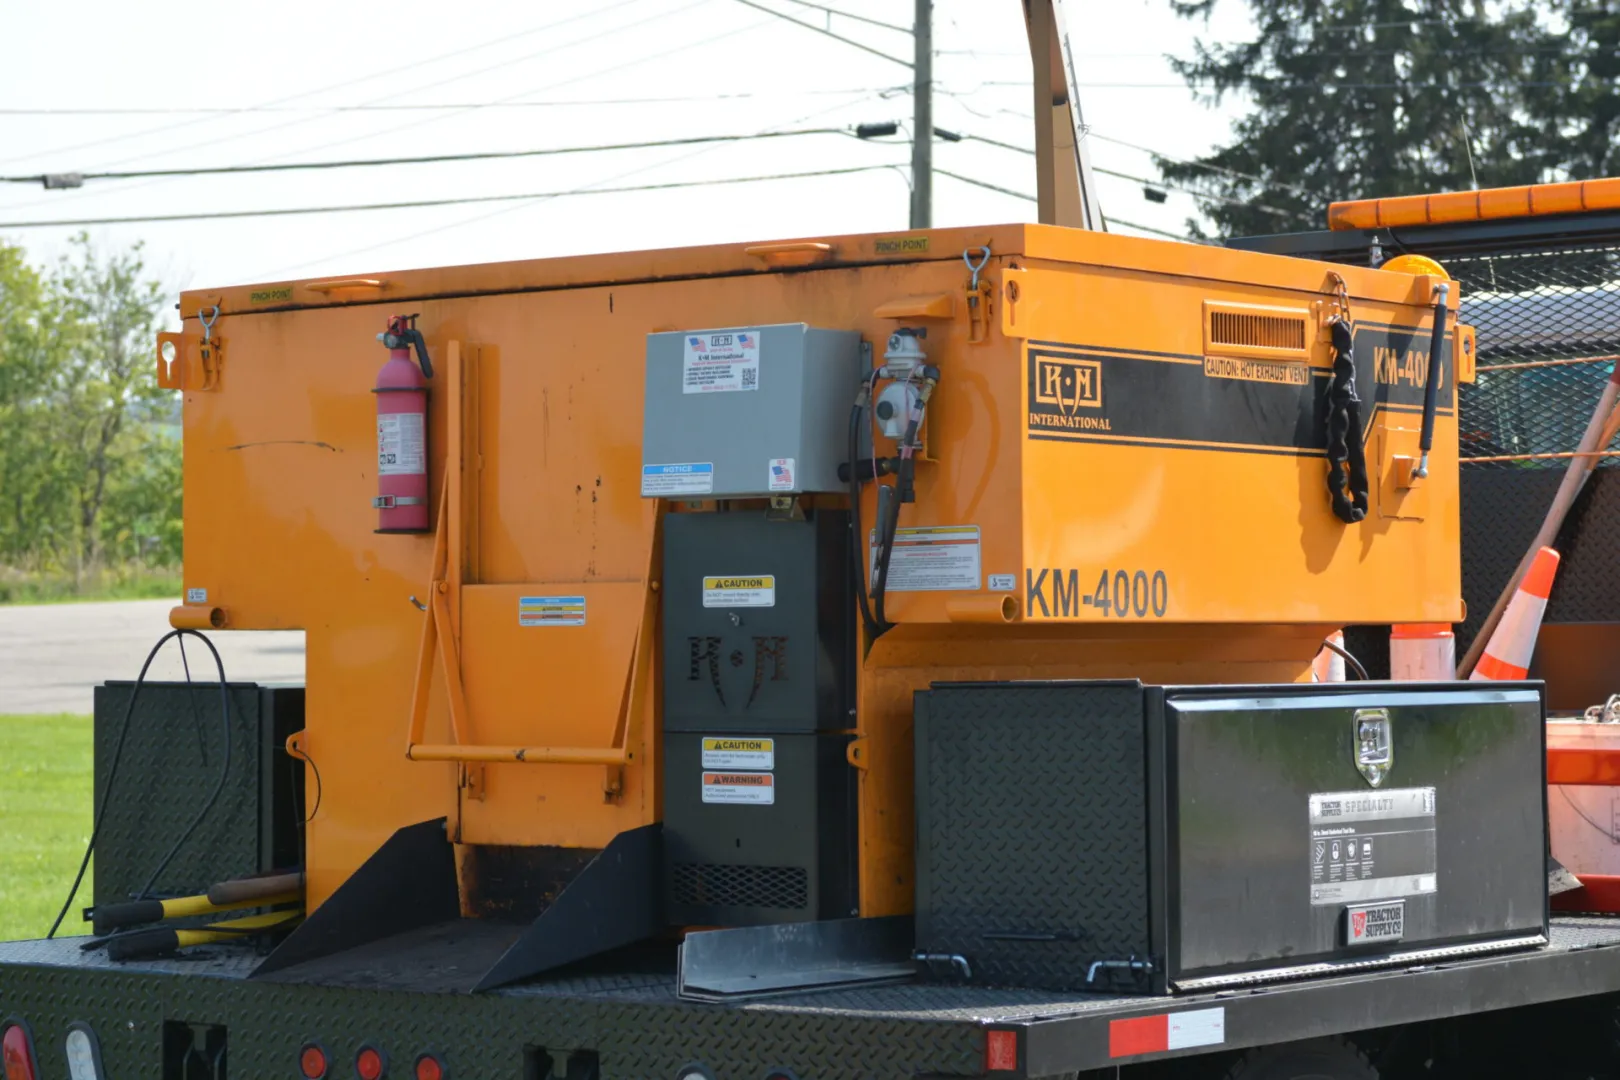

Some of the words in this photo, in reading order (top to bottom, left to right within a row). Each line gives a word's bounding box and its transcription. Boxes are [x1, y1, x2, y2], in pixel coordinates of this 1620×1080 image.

[903, 239, 927, 250] POINT
[1205, 358, 1239, 375] CAUTION:
[1240, 361, 1255, 379] HOT
[1256, 363, 1287, 381] EXHAUST
[1289, 366, 1308, 383] VENT
[1029, 413, 1111, 430] INTERNATIONAL
[662, 465, 693, 473] NOTICE
[723, 579, 763, 588] CAUTION
[1026, 568, 1168, 618] KM-4000
[722, 741, 762, 750] CAUTION
[721, 775, 763, 785] WARNING
[1345, 798, 1394, 813] SPECIALTY
[1366, 907, 1401, 923] TRACTOR
[1366, 922, 1392, 937] SUPPLY
